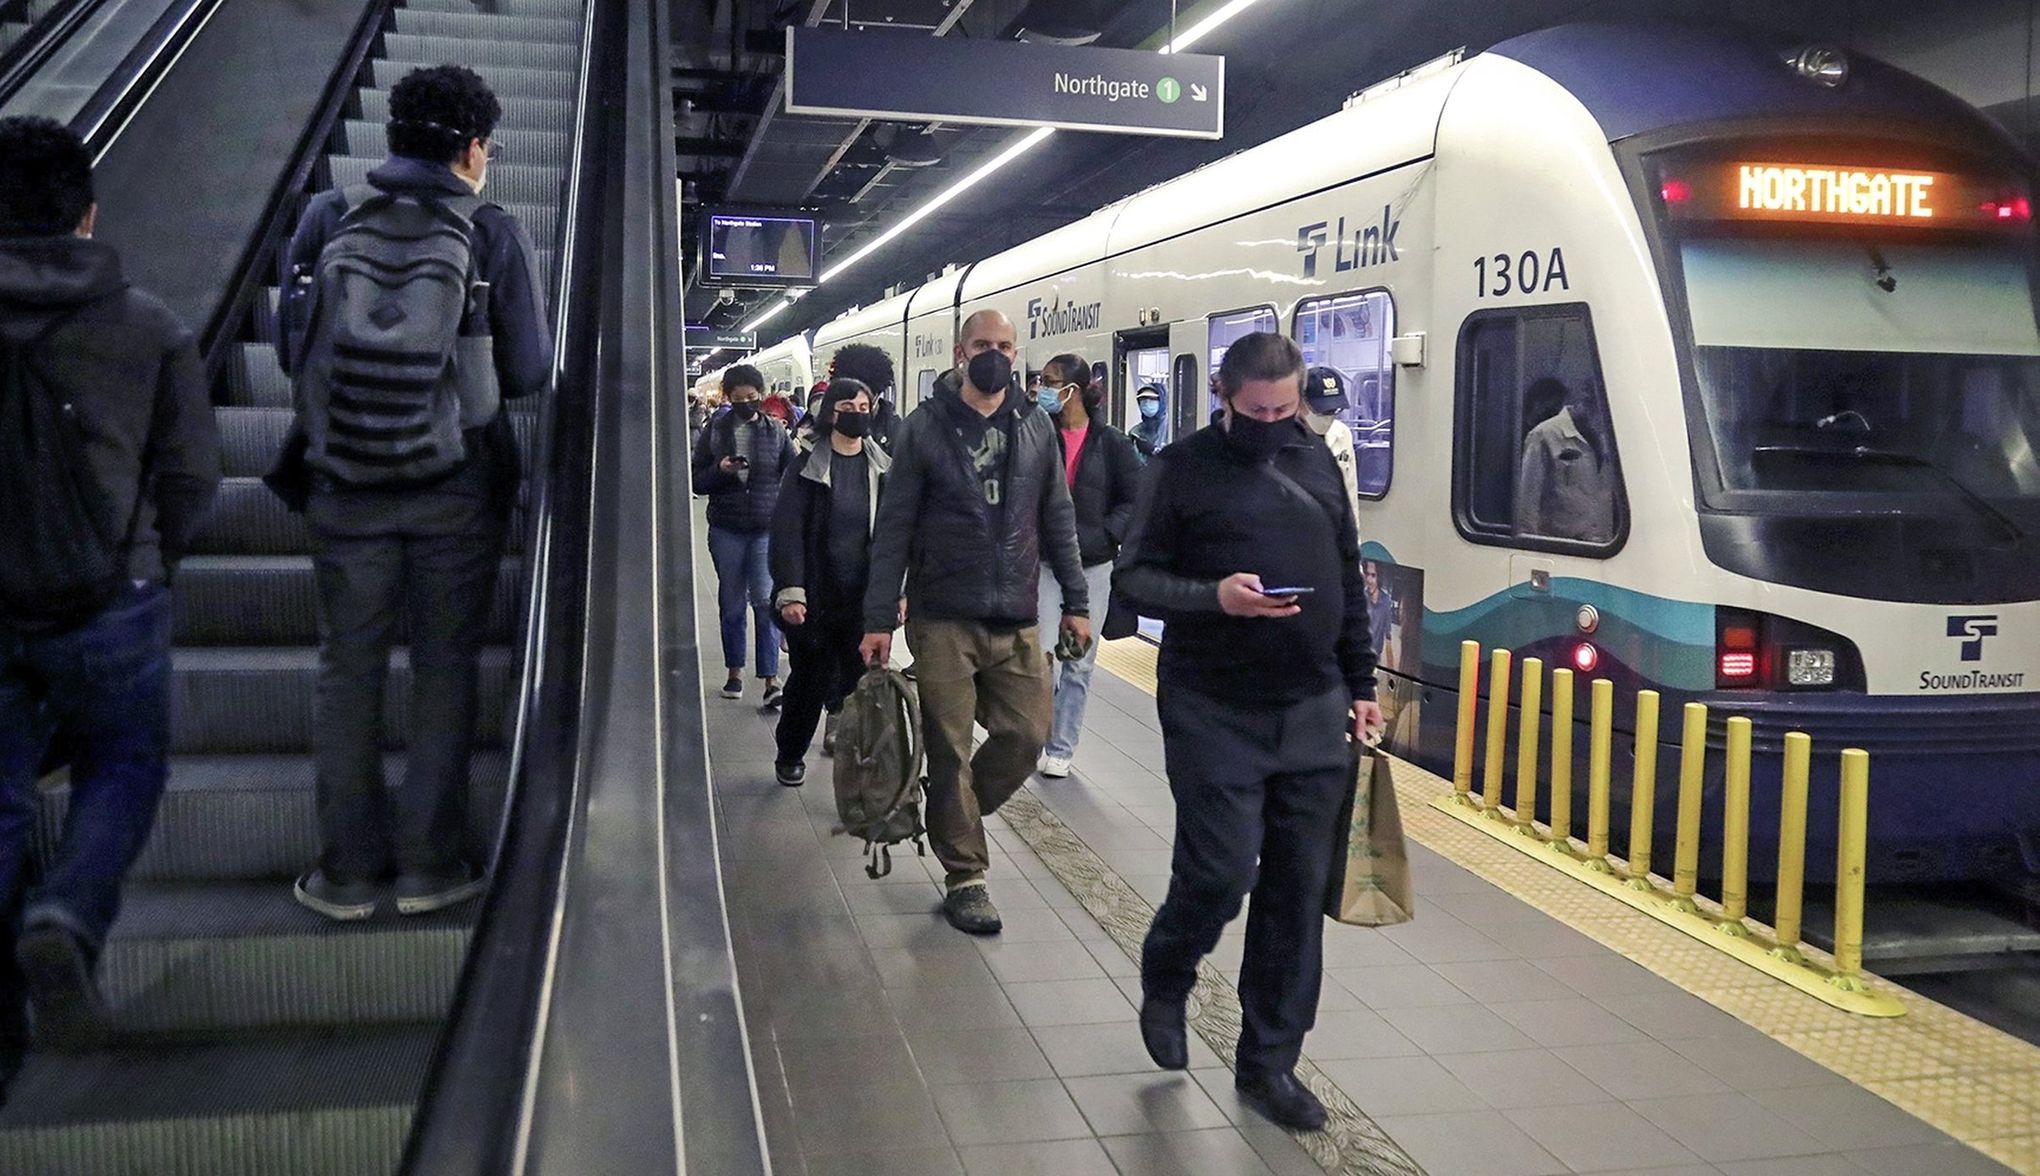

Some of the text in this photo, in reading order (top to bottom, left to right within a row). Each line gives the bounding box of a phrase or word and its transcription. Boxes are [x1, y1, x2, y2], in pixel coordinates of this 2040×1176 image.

[1055, 73, 1173, 101] Northgate 1
[1739, 165, 1934, 217] NORTHGATE
[1335, 204, 1400, 272] Link
[1474, 247, 1569, 297] 130A
